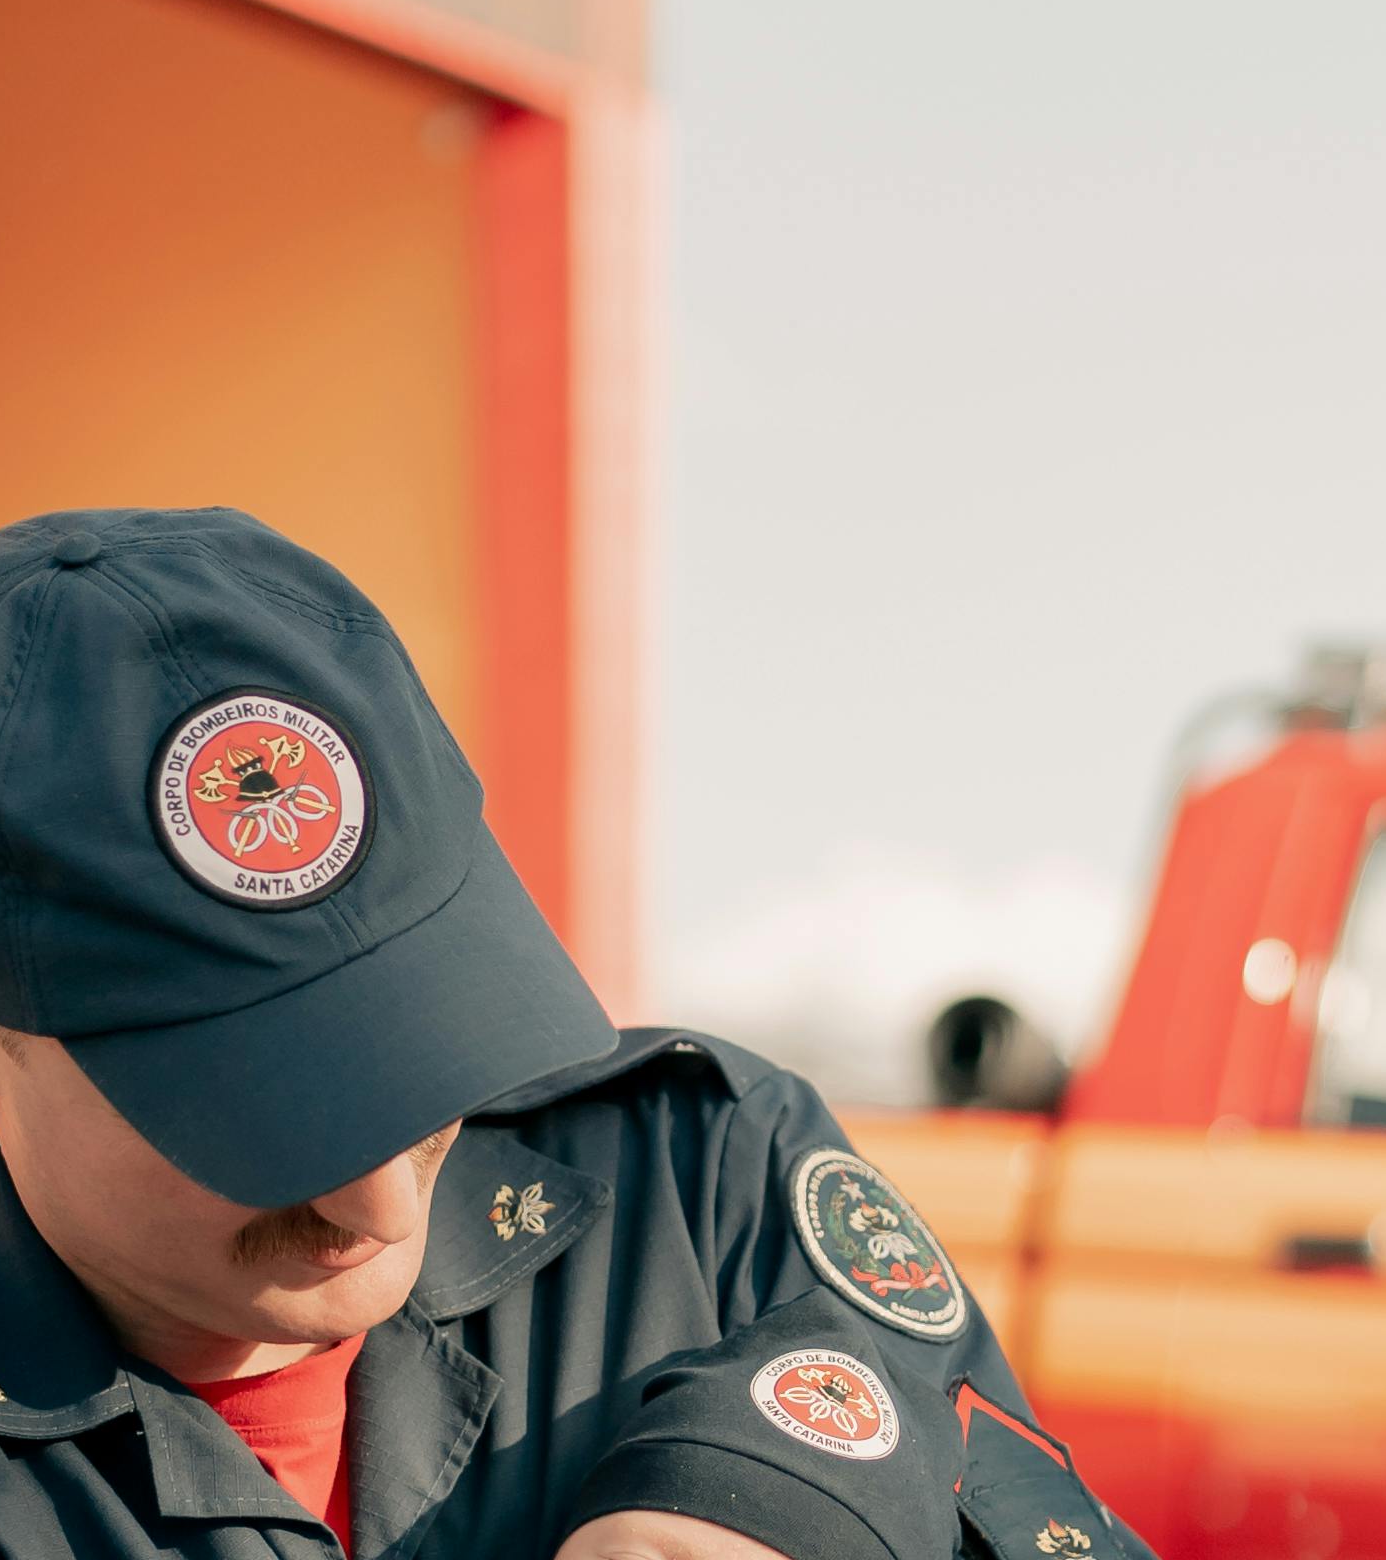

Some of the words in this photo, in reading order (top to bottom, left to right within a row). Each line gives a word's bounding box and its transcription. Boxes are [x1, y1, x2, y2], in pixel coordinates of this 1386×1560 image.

[180, 702, 279, 749] BOMBEIROS
[283, 710, 346, 765] MILITAR
[169, 749, 189, 772] DE
[165, 777, 191, 837] CORPO
[234, 872, 295, 896] SANTA
[299, 822, 360, 890] CATARINA
[766, 1354, 804, 1378] CORPO
[805, 1353, 824, 1363] DE
[827, 1354, 887, 1408] BOMBEIROS
[761, 1399, 793, 1428] SANTA
[792, 1425, 855, 1454] CATARINA
